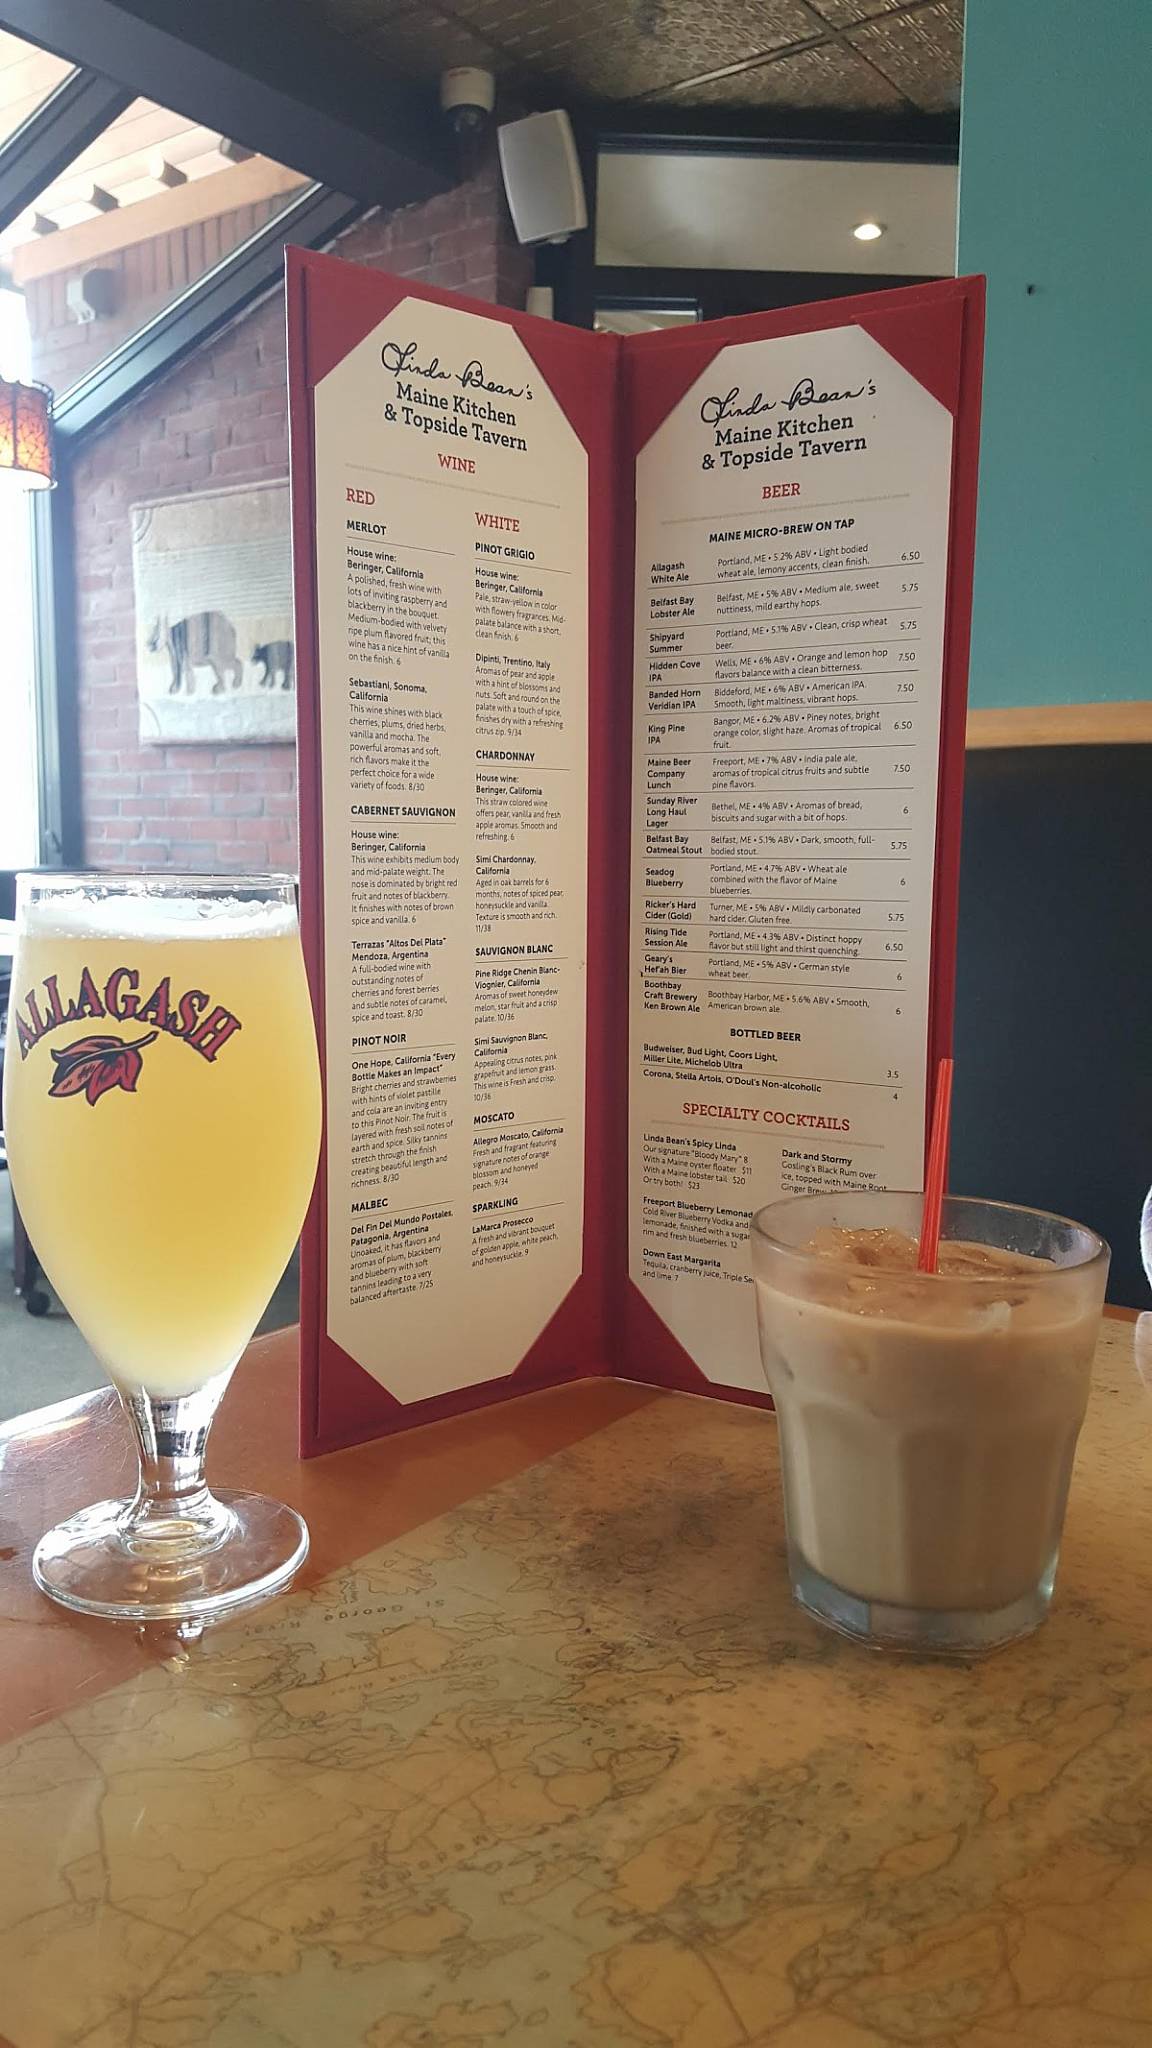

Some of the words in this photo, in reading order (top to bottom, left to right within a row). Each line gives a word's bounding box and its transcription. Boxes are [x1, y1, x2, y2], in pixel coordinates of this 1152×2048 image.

[381, 342, 452, 380] Linda
[454, 360, 533, 400] Bean's
[396, 380, 449, 410] Maine
[452, 394, 517, 427] Kitchen
[700, 387, 777, 429] Linda
[780, 377, 876, 411] Bean's
[384, 403, 398, 422] &
[401, 405, 468, 438] Topside
[471, 422, 528, 452] Tavern
[714, 425, 772, 447] Maine
[776, 413, 854, 439] Kitchen
[701, 453, 716, 470] &
[719, 441, 794, 470] Topside
[798, 437, 867, 458] Tavern
[437, 453, 476, 474] WINE
[346, 487, 376, 506] RED
[762, 482, 801, 500] BEER
[346, 519, 387, 536] MERLOT
[474, 512, 520, 533] WHITE
[709, 530, 742, 543] MAINE
[743, 522, 814, 540] MICRO-BREW
[815, 520, 832, 532] ON
[834, 518, 855, 530] TAP
[346, 545, 374, 559] House
[374, 551, 397, 563] wine:
[475, 542, 503, 556] PINOT
[503, 547, 535, 561] GRIGIO
[753, 553, 767, 564] ME
[794, 549, 813, 562] ABV
[818, 547, 841, 559] Light
[840, 543, 869, 556] bodied
[901, 550, 921, 562] 6.50
[650, 561, 685, 573] Allagash
[650, 574, 675, 584] White
[675, 572, 690, 582] Ale
[388, 578, 408, 591] fresh
[407, 582, 425, 594] wine
[426, 585, 442, 595] with
[901, 582, 919, 593] 5.75
[650, 597, 678, 608] Belfast
[679, 596, 695, 606] Bay
[650, 609, 681, 619] Lobster
[681, 607, 695, 617] Ale
[900, 620, 917, 631] 5.75
[649, 631, 685, 644] Shipyard
[649, 645, 684, 654] Summer
[502, 655, 535, 669] Trentino,
[535, 659, 551, 671] Italy
[898, 652, 916, 662] 7.50
[649, 661, 679, 671] Hidden
[679, 659, 701, 669] Cove
[649, 673, 663, 682] IPA
[349, 677, 392, 692] Sebastiani,
[393, 681, 427, 694] Sonoma,
[897, 682, 914, 693] 7.50
[349, 690, 389, 703] California
[648, 689, 679, 699] Banded
[680, 689, 701, 698] Horn
[648, 700, 681, 711] Veridian
[682, 700, 696, 709] IPA
[648, 724, 666, 735] King
[667, 724, 686, 733] Pine
[893, 720, 913, 730] 6.50
[647, 735, 661, 745] IPA
[475, 749, 535, 762] CHARDONNAY
[647, 758, 672, 767] Maine
[673, 757, 692, 767] Beer
[893, 763, 911, 773] 7.50
[647, 769, 686, 780] Company
[647, 780, 672, 790] Lunch
[646, 796, 676, 807] Sunday
[677, 796, 698, 805] River
[350, 805, 401, 816] CABERNET
[401, 806, 456, 818] SAUVIGNON
[646, 807, 667, 818] Long
[668, 807, 687, 816] Haul
[902, 806, 909, 815] 6
[646, 819, 669, 830] Lager
[646, 834, 673, 843] Belfast
[674, 834, 689, 845] Bay
[890, 841, 908, 850] 5.75
[645, 845, 680, 854] Oatmeal
[680, 845, 703, 855] Stout
[645, 867, 675, 878] Seadog
[645, 878, 684, 889] Blueberry
[710, 874, 747, 884] combined
[746, 874, 765, 884] with
[765, 875, 779, 884] the
[779, 875, 803, 885] flavor
[802, 875, 813, 885] of
[812, 875, 838, 885] Maine
[900, 878, 906, 886] 6
[645, 899, 676, 910] Ricker's
[676, 900, 697, 910] Hard
[351, 916, 370, 927] spice
[370, 915, 385, 925] and
[411, 914, 417, 924] 6
[644, 910, 667, 920] Cider
[667, 910, 692, 921] (Gold)
[887, 913, 905, 922] 5.75
[644, 927, 669, 938] Rising
[669, 927, 688, 937] Tide
[644, 938, 674, 948] Session
[673, 939, 688, 948] Ale
[885, 942, 904, 952] 6.50
[475, 945, 525, 957] SAUVIGNON
[526, 944, 554, 954] BLANC
[644, 953, 673, 965] Geary's
[896, 972, 903, 981] 6
[644, 979, 682, 992] Boothbay
[643, 990, 664, 1000] Craft
[665, 991, 698, 1004] Brewery
[644, 1001, 660, 1010] Ken
[660, 1002, 687, 1012] Brown
[687, 1004, 701, 1013] Ale
[895, 1007, 902, 1016] 6
[15, 966, 243, 1063] ALLAGASH
[352, 1035, 382, 1047] PINOT
[383, 1033, 407, 1045] NOIR
[730, 1028, 775, 1040] BOTTLED
[776, 1031, 801, 1042] BEER
[643, 1043, 686, 1055] Budweiser,
[687, 1046, 703, 1058] Bud
[704, 1048, 727, 1058] Light,
[728, 1049, 753, 1060] Coors
[754, 1051, 778, 1063] Light,
[892, 1092, 898, 1101] 4
[473, 1111, 515, 1125] MOSCATO
[682, 1102, 760, 1122] SPECIALTY
[763, 1110, 850, 1132] COCKTAILS
[643, 1133, 665, 1143] Linda
[665, 1135, 691, 1146] Bean's
[692, 1138, 714, 1151] Spicy
[714, 1141, 737, 1152] Linda
[781, 1149, 802, 1159] Dark
[803, 1153, 820, 1162] and
[820, 1153, 853, 1167] Stormy
[351, 1198, 389, 1213] MALBEC
[472, 1196, 519, 1213] SPARKLING
[472, 1222, 502, 1234] LaMarca
[502, 1216, 534, 1229] Prosecco
[642, 1248, 666, 1259] Down
[666, 1251, 683, 1262] East
[683, 1254, 721, 1268] Margarita
